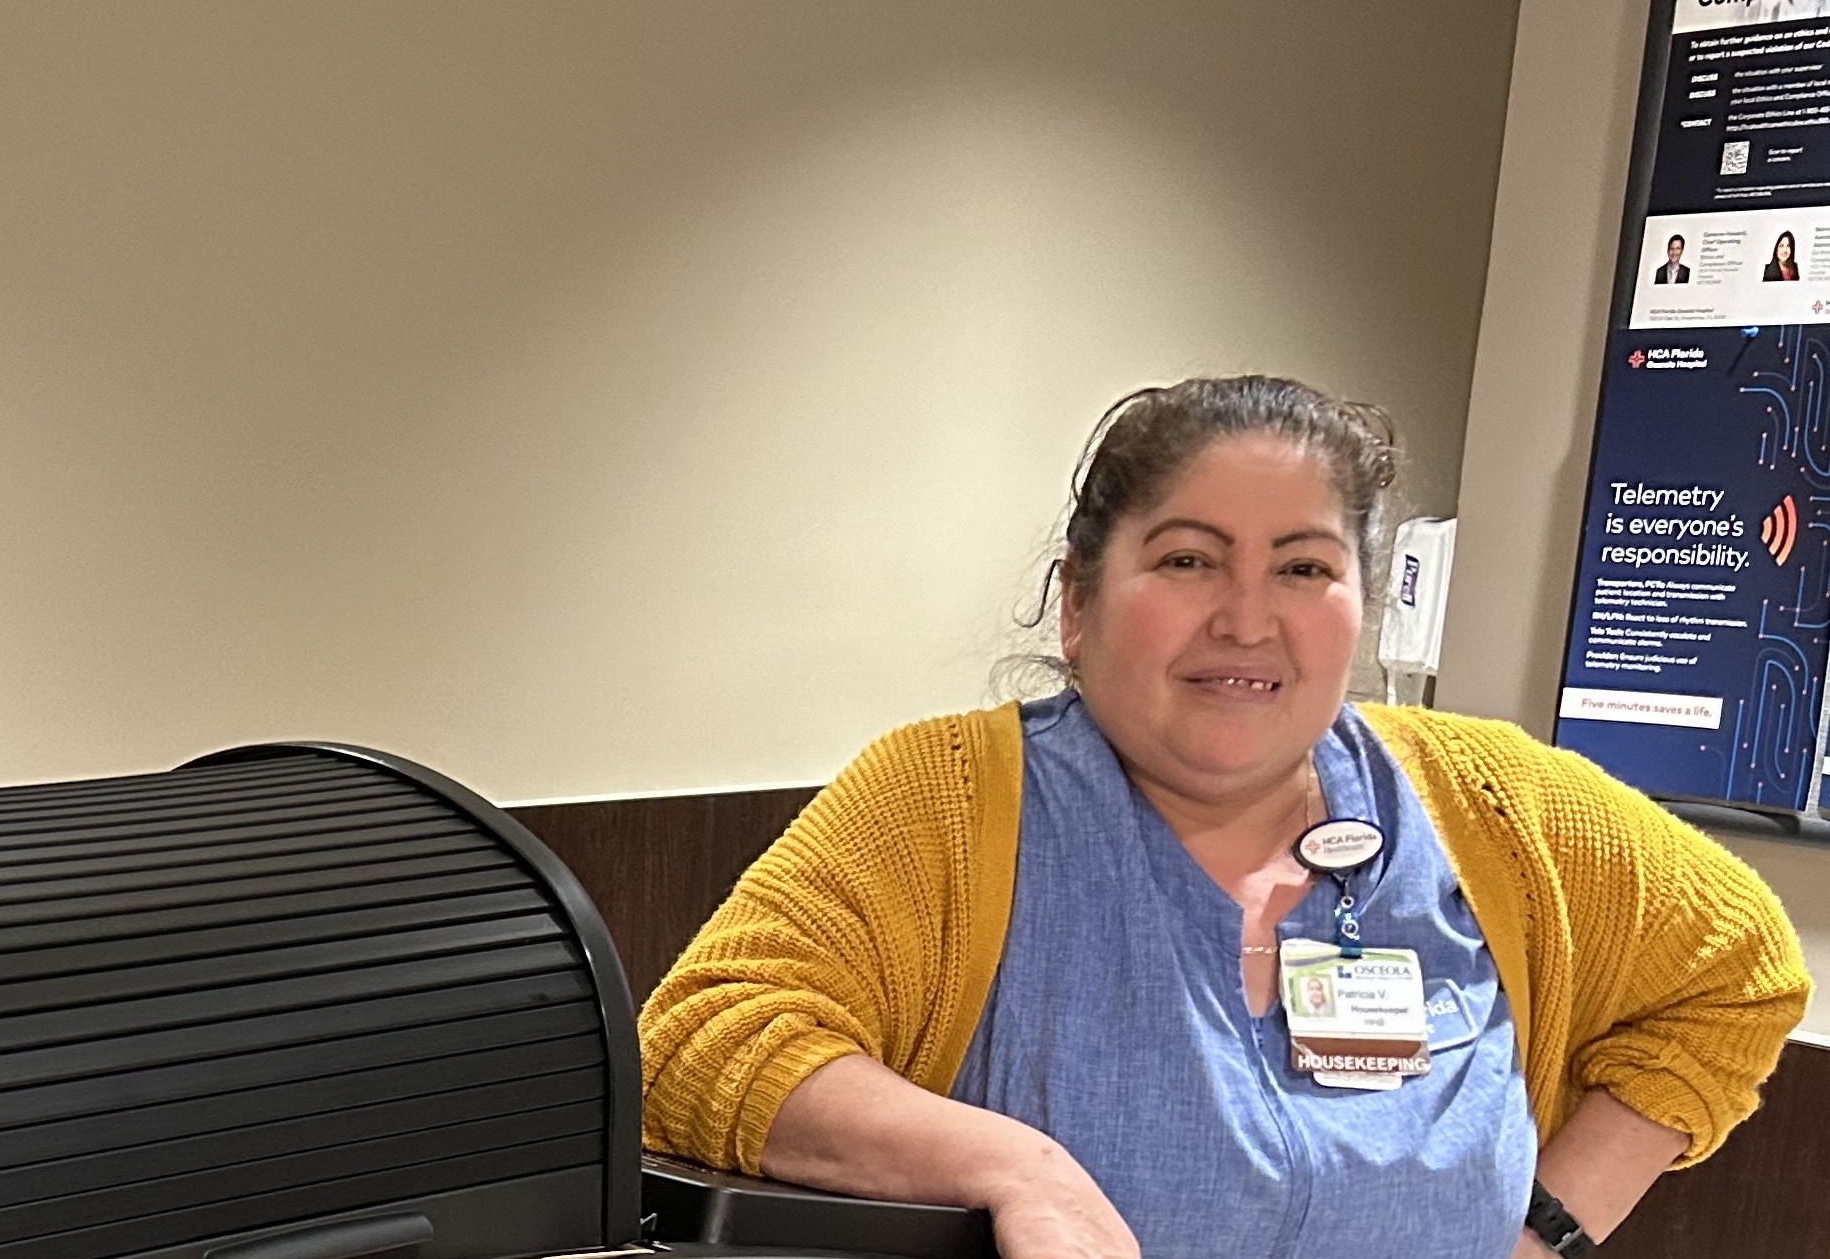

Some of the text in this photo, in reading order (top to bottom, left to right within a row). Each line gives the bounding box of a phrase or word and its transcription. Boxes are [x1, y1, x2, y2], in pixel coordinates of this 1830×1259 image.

[1648, 348, 1704, 358] HCA Florida
[1611, 482, 1724, 512] Telemetry
[1606, 513, 1624, 534] is
[1602, 544, 1750, 572] responsibility.
[1582, 698, 1604, 708] Five
[1607, 701, 1650, 712] minutes
[1654, 704, 1682, 714] saves
[1694, 706, 1712, 717] life.
[1323, 832, 1377, 844] HCA Florida
[1354, 965, 1411, 976] OSCEOLA
[1338, 988, 1376, 1000] Patricia
[1426, 1000, 1459, 1017] ida
[1298, 1054, 1429, 1072] HOUSEKEEPING
